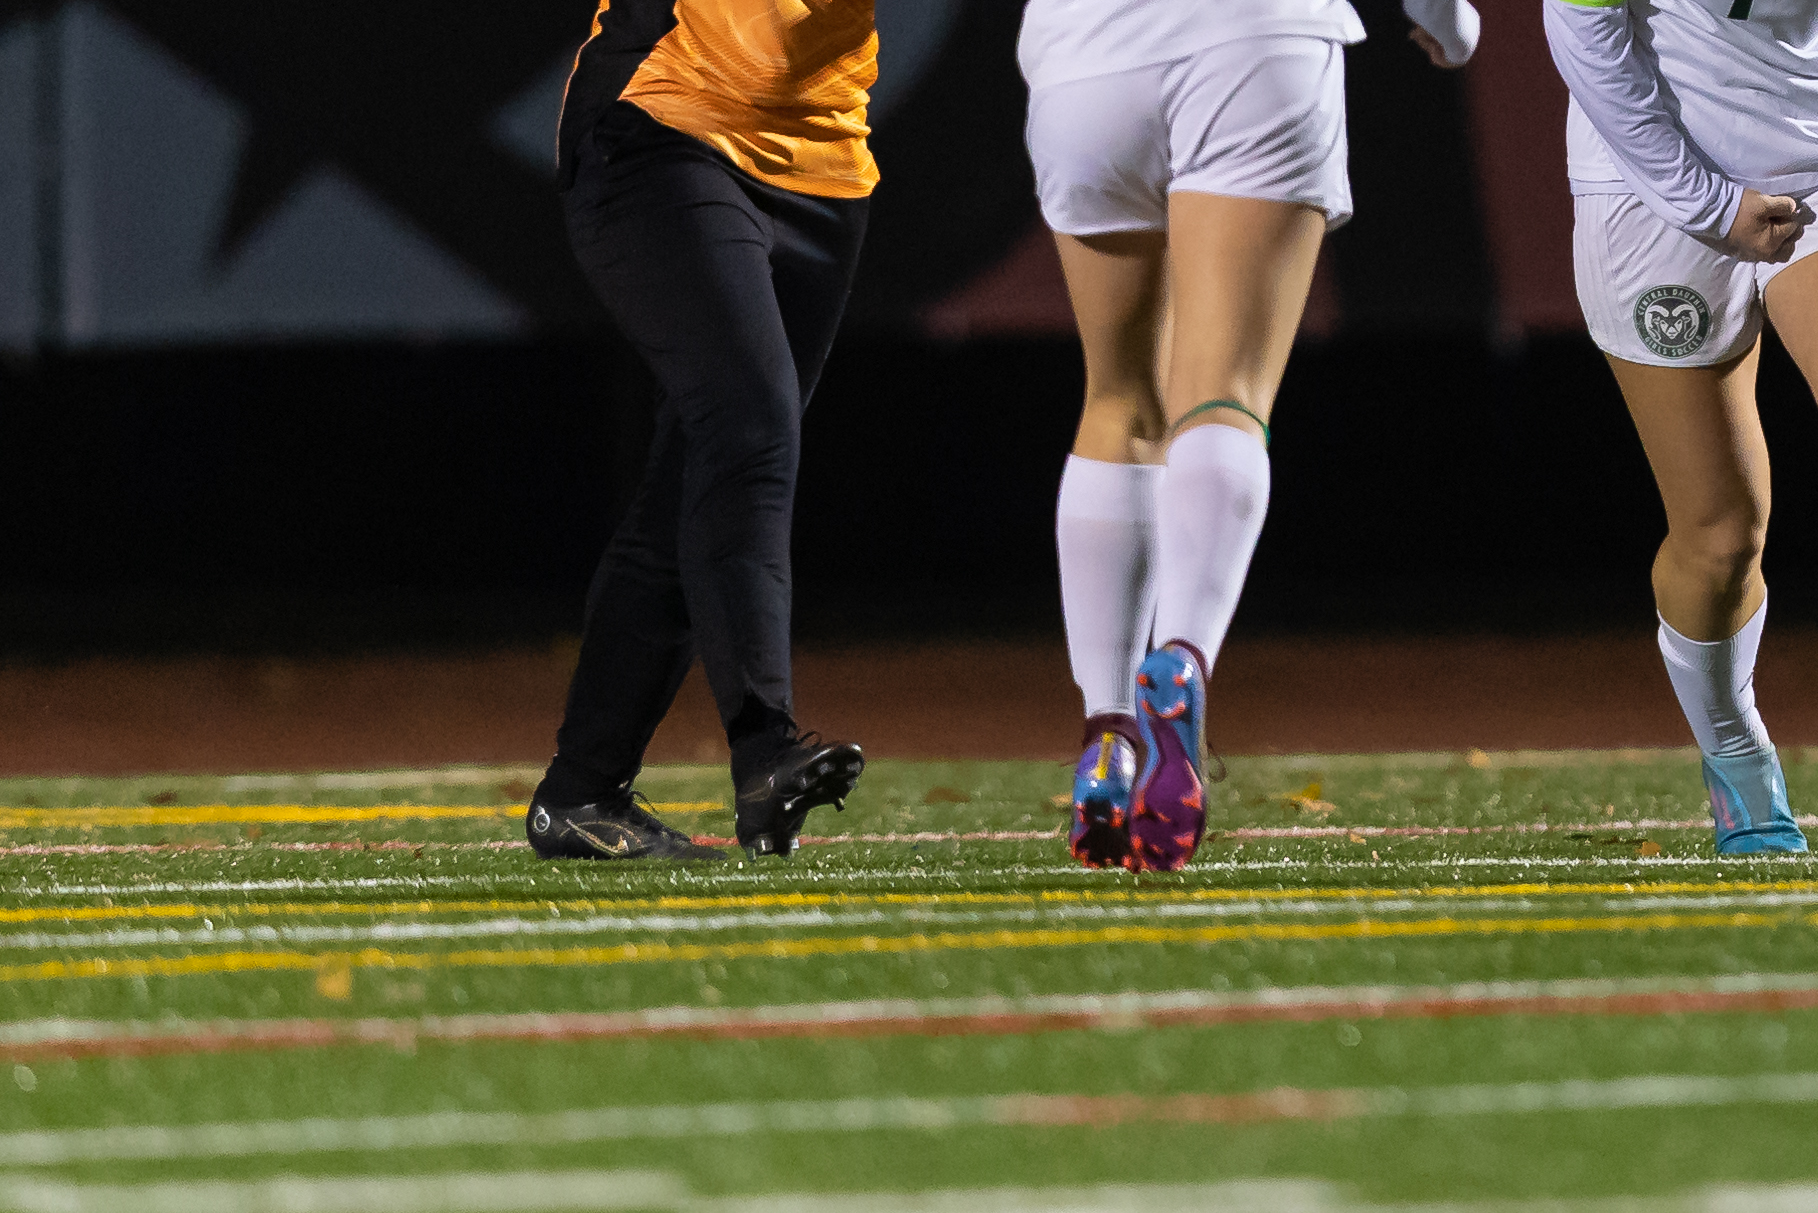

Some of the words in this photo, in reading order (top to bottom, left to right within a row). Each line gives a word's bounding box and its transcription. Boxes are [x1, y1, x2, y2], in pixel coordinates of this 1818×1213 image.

[1637, 289, 1668, 316] CENTRAL
[1672, 288, 1706, 314] DAUPHIN
[1644, 336, 1668, 355] GIRLS
[1671, 334, 1703, 357] SOCCER
